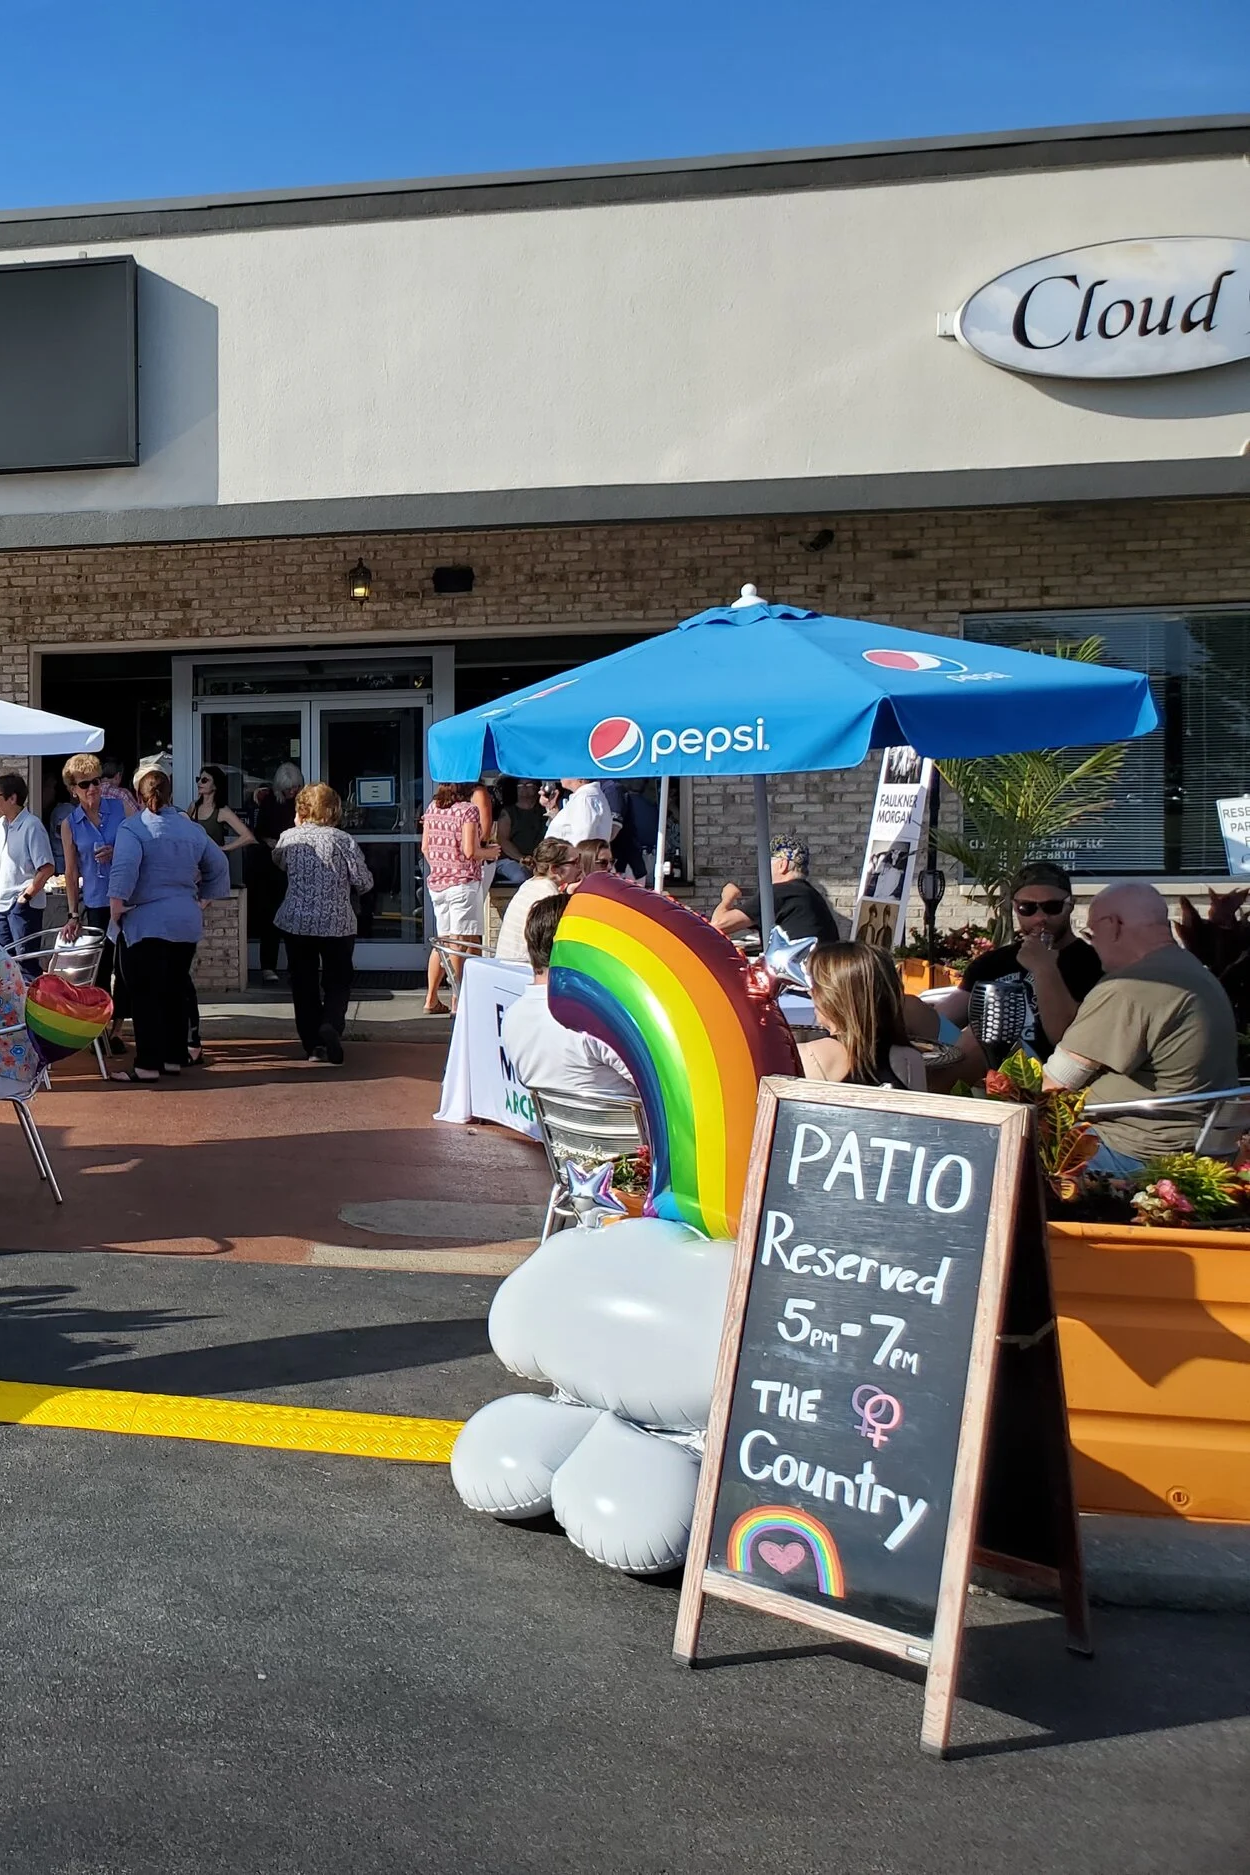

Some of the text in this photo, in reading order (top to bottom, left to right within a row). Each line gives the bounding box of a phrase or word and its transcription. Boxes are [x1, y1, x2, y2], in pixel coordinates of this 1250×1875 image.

[1012, 270, 1237, 350] Cloud
[650, 717, 765, 763] pepsi
[876, 809, 912, 824] MORGAN
[879, 793, 919, 808] FAULKNER
[1222, 806, 1250, 818] RESE
[787, 1123, 973, 1214] PATIO
[761, 1210, 952, 1305] Reserved
[751, 1379, 822, 1423] THE
[739, 1429, 928, 1551] Country
